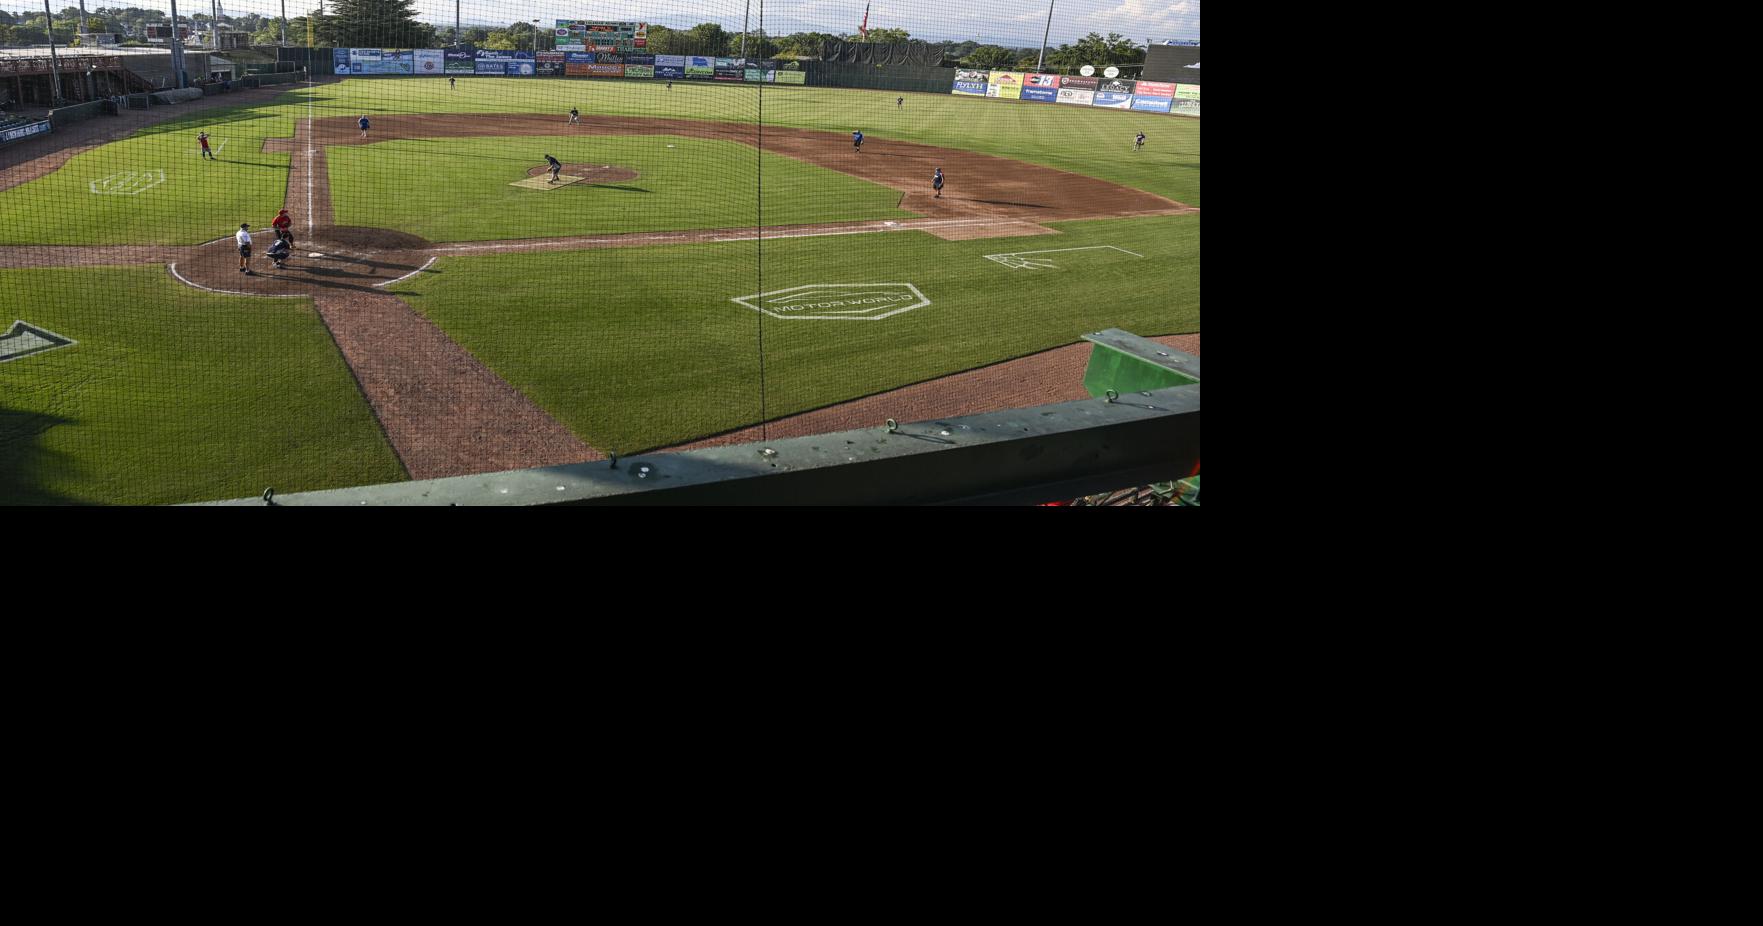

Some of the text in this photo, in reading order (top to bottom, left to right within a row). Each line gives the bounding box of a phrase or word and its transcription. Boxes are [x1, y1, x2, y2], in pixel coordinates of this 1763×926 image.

[1039, 75, 1054, 86] 13
[773, 294, 913, 314] MOTOR WORLD
